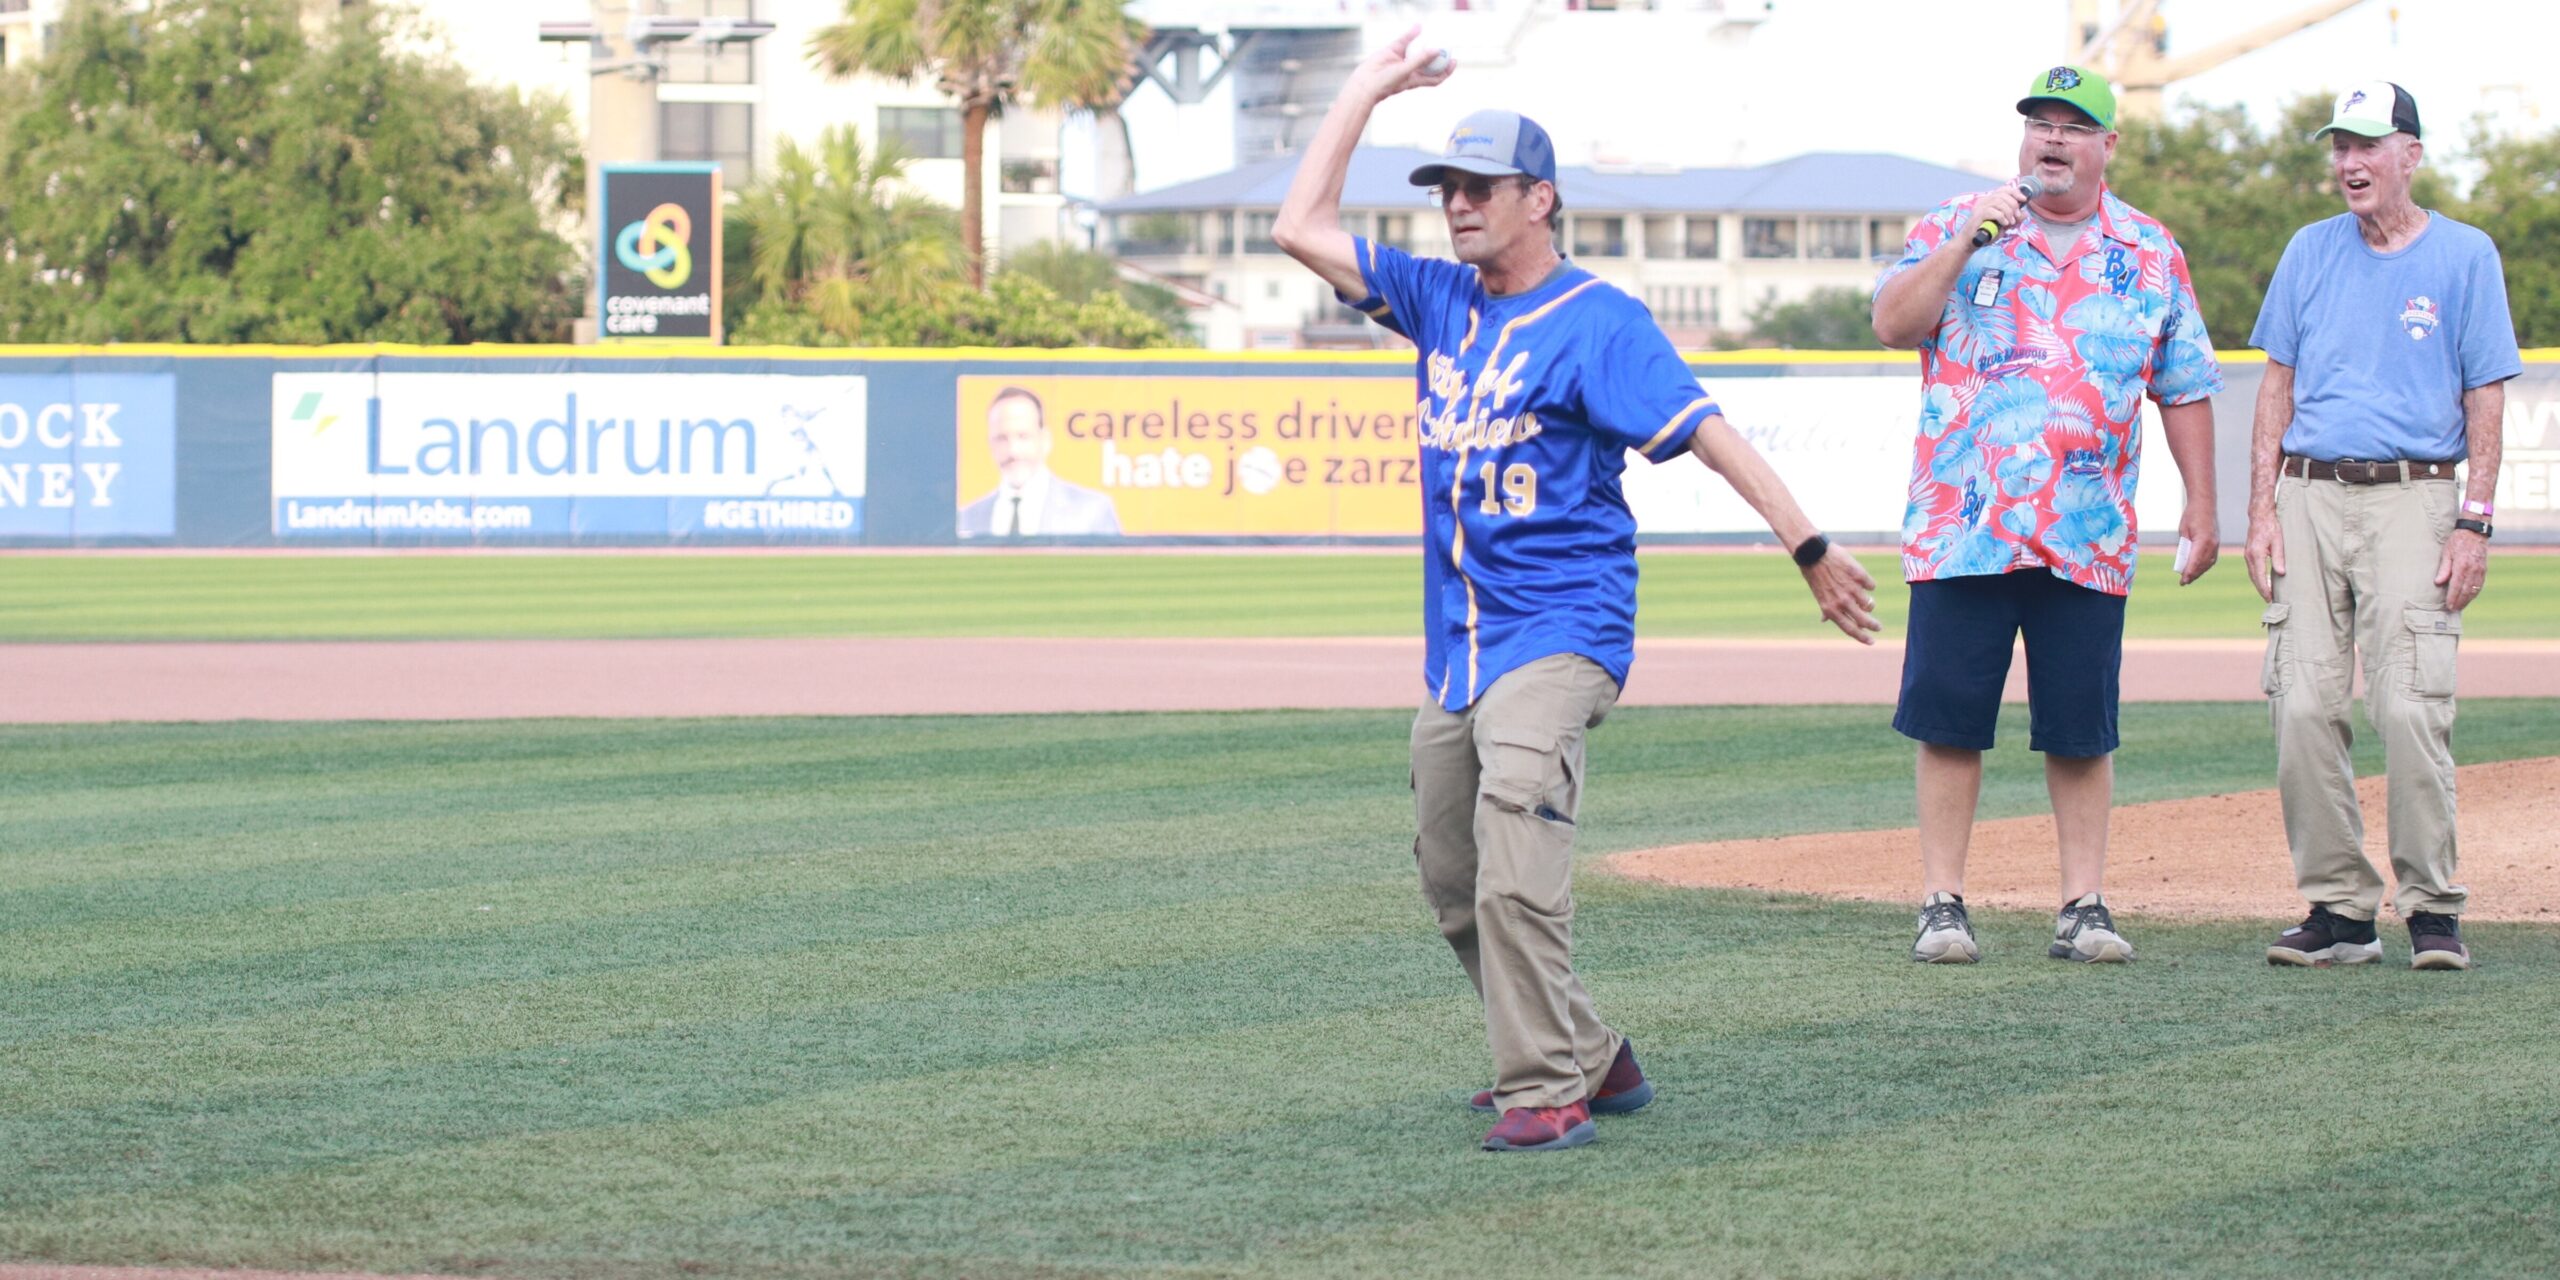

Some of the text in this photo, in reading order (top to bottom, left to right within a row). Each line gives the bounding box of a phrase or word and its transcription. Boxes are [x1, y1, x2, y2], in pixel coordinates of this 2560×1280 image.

[606, 292, 710, 315] covenant
[606, 314, 658, 333] care
[1473, 351, 1530, 410] of
[0, 403, 122, 449] OCK
[365, 392, 757, 475] Landrum
[1068, 400, 1258, 439] careless
[1102, 440, 1212, 488] hate
[1480, 461, 1537, 517] 19
[288, 499, 532, 529] LandrumJobs.com
[703, 500, 854, 529] #GETHIRED
